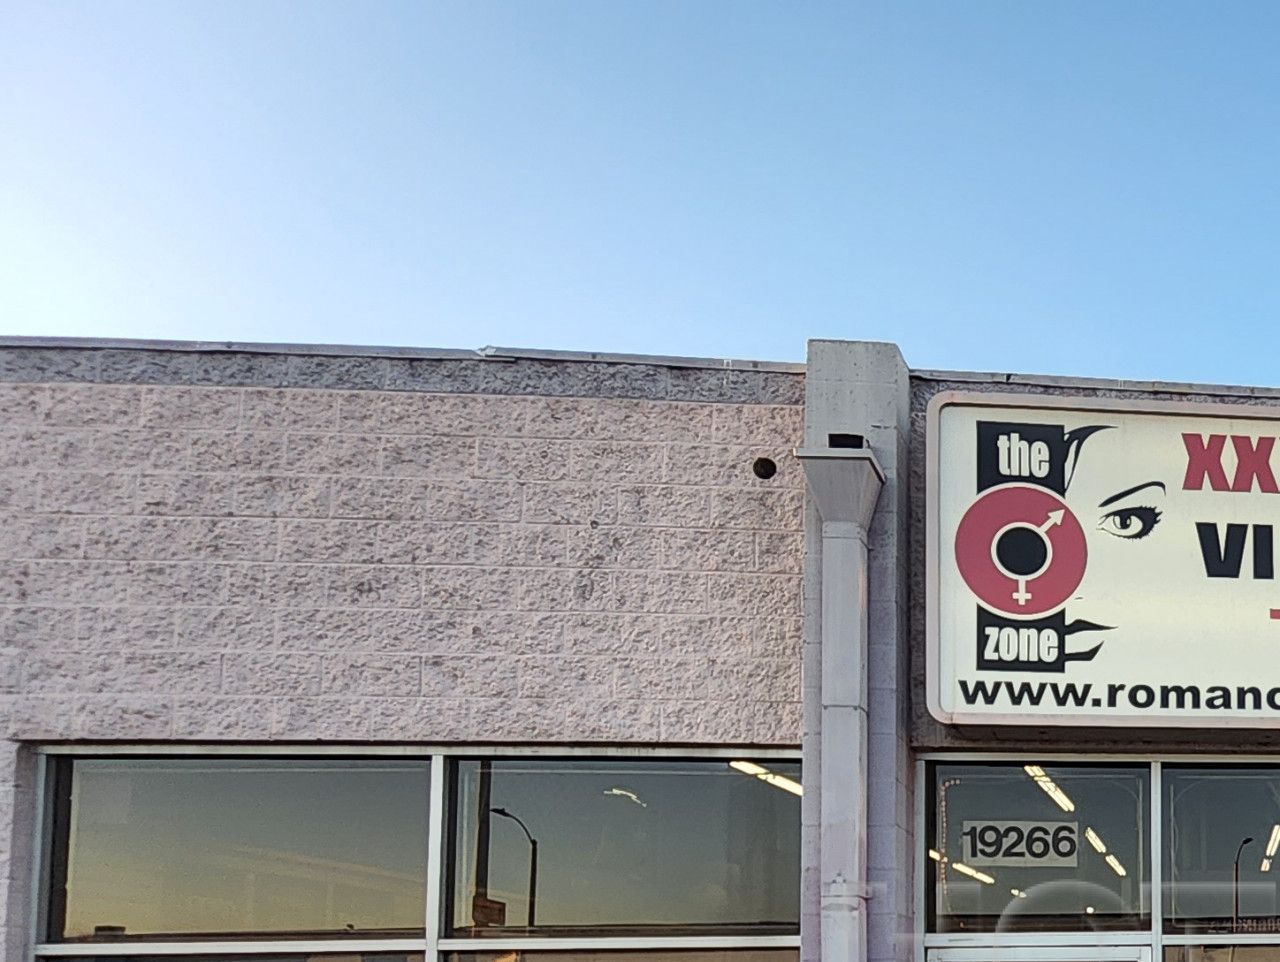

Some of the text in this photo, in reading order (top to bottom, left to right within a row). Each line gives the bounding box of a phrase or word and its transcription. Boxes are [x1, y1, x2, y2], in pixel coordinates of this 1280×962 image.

[997, 431, 1050, 478] the
[983, 624, 1059, 663] zone
[962, 825, 1077, 859] 19266
